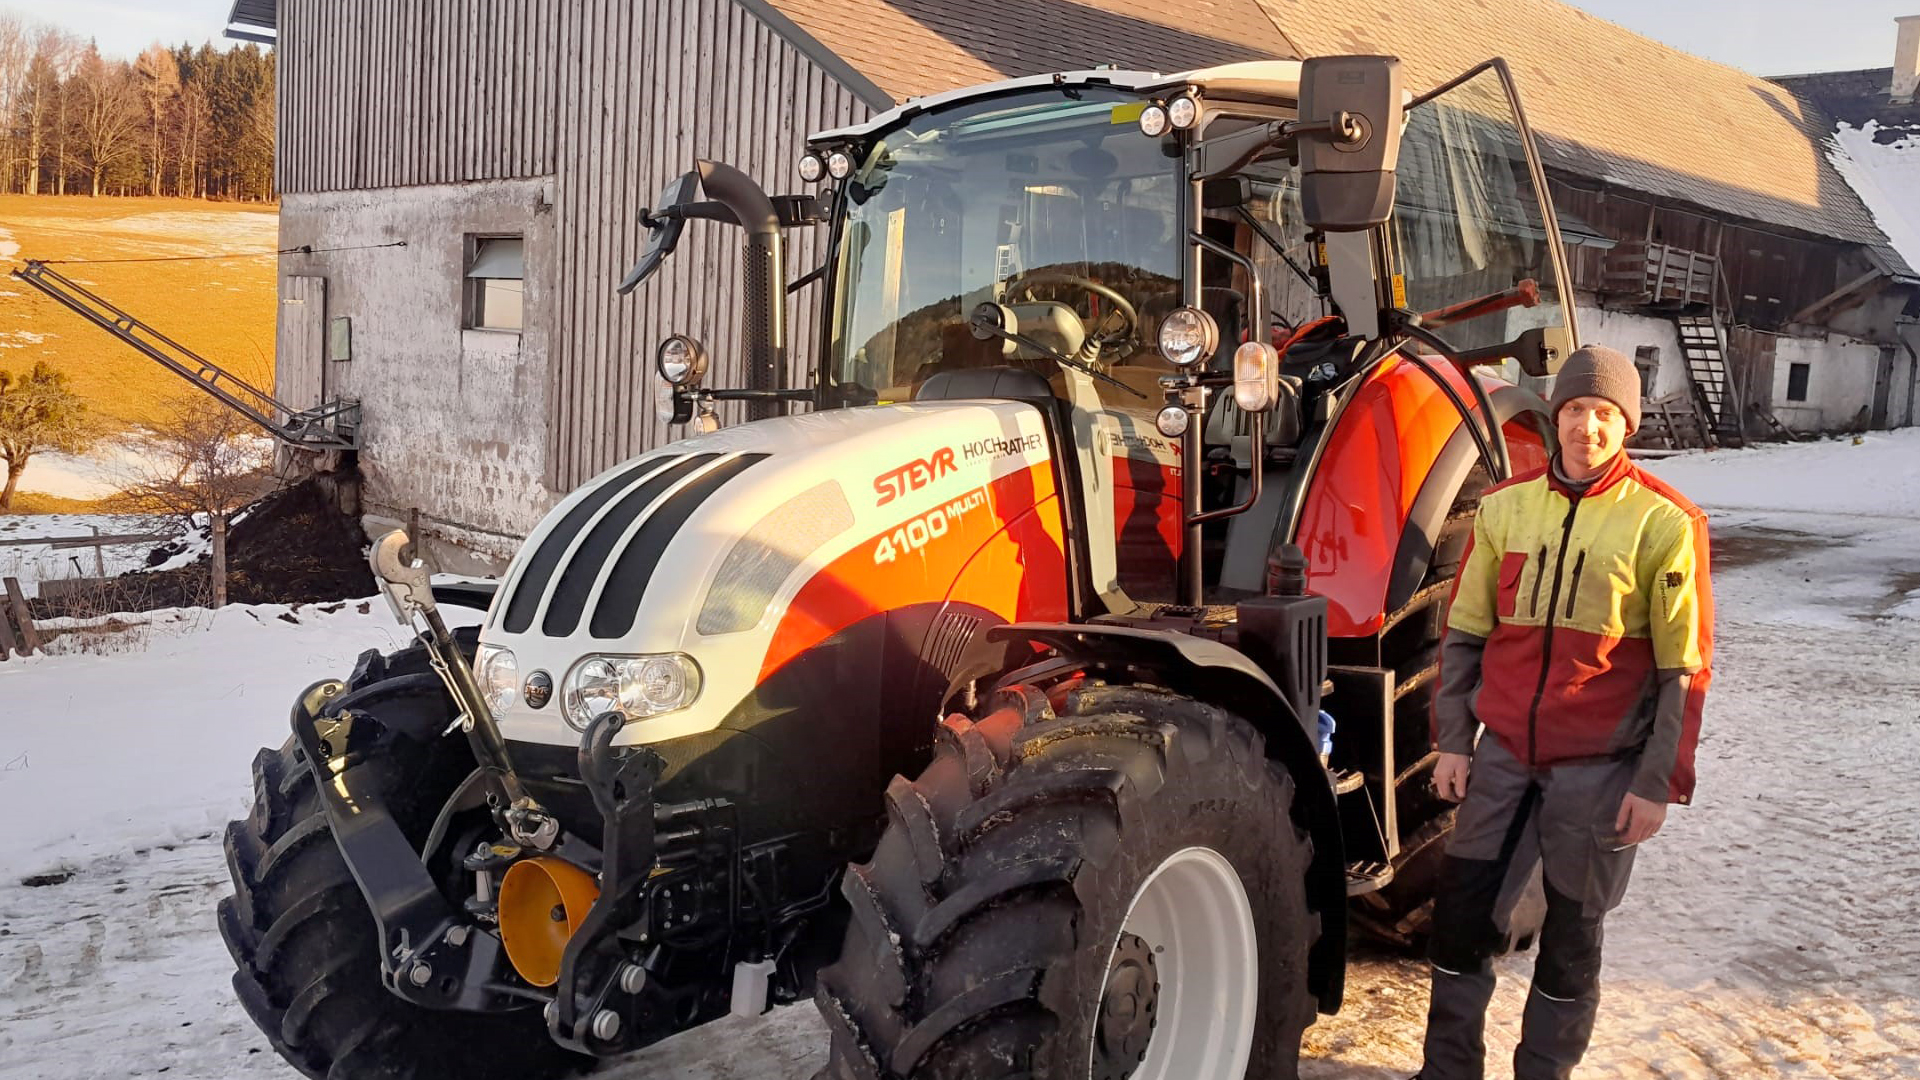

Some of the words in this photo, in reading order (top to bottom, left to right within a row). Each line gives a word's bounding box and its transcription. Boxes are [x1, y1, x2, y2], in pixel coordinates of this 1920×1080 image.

[873, 446, 959, 507] STEYR
[962, 434, 1043, 461] HOCHRATHER
[873, 509, 948, 564] 4100
[946, 491, 985, 519] MULTI
